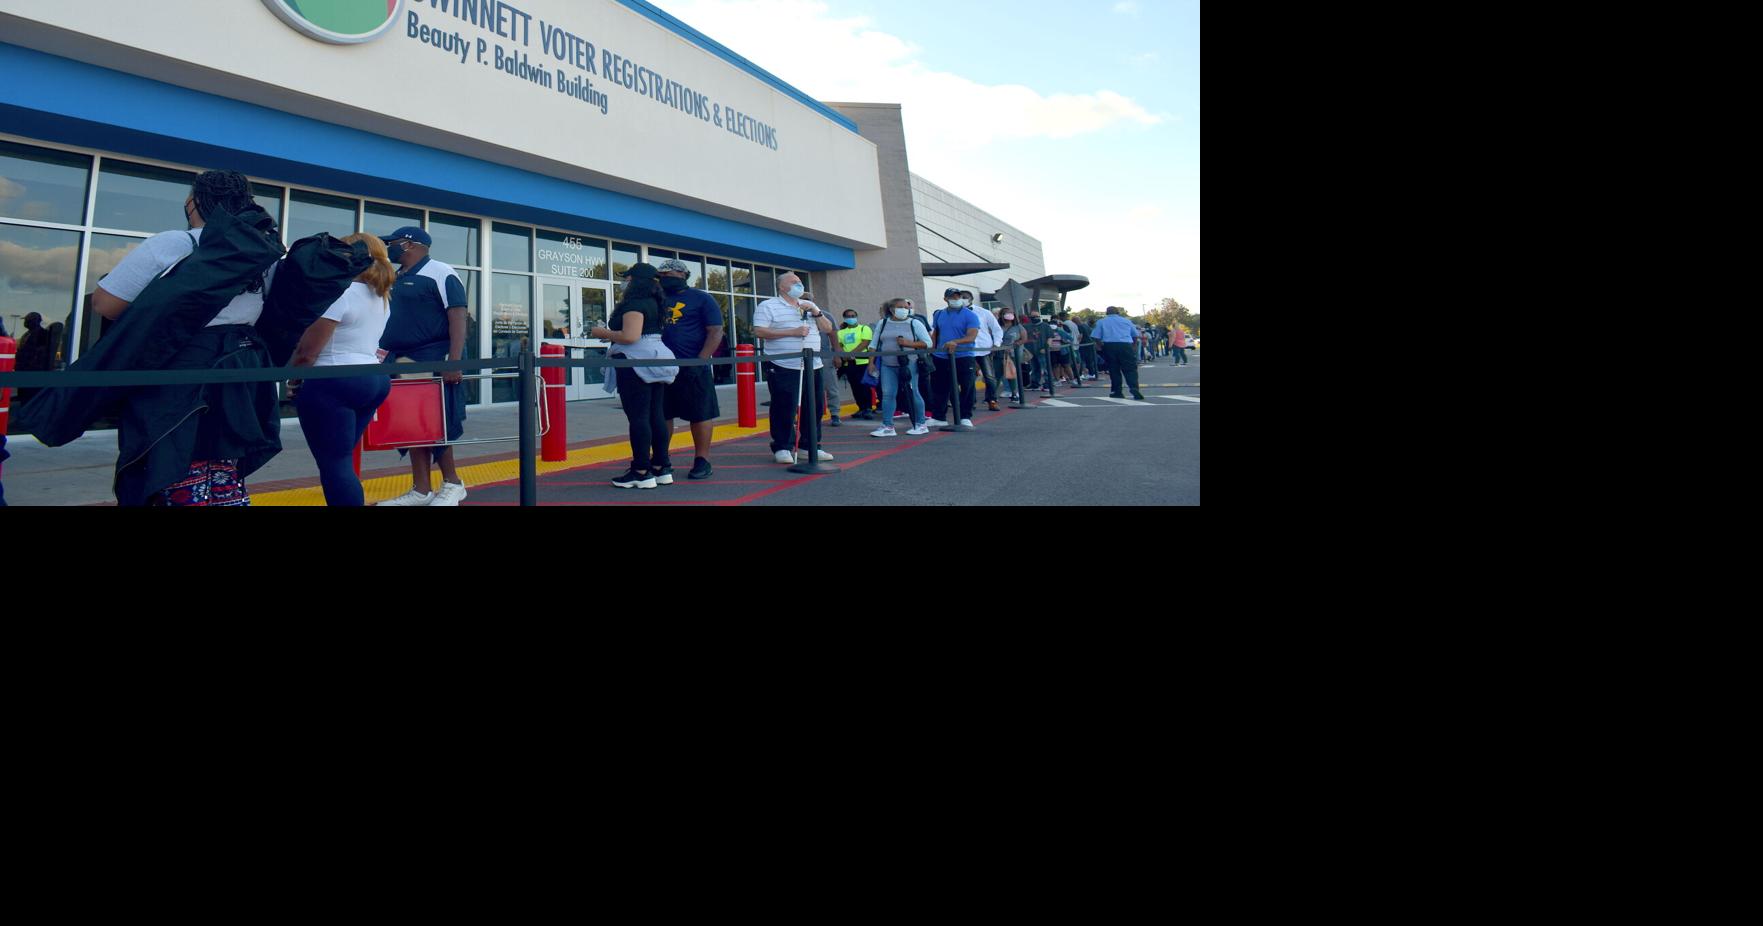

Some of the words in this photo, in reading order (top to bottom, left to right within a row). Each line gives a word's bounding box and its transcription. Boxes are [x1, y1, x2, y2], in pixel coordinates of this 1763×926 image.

[407, 9, 470, 64] Beauty
[476, 37, 488, 66] P.
[495, 44, 552, 89] Baldwin
[557, 69, 608, 115] Building
[411, 0, 532, 46] INNETT
[540, 20, 597, 75] VOTER
[602, 49, 710, 122] REGISTRATIONS
[713, 103, 723, 128] &
[725, 106, 778, 151] ELECTIONS
[562, 236, 583, 250] 455
[538, 249, 583, 264] GRAYSON
[585, 256, 605, 266] HWY
[551, 264, 577, 277] SUITE
[579, 268, 594, 278] 200
